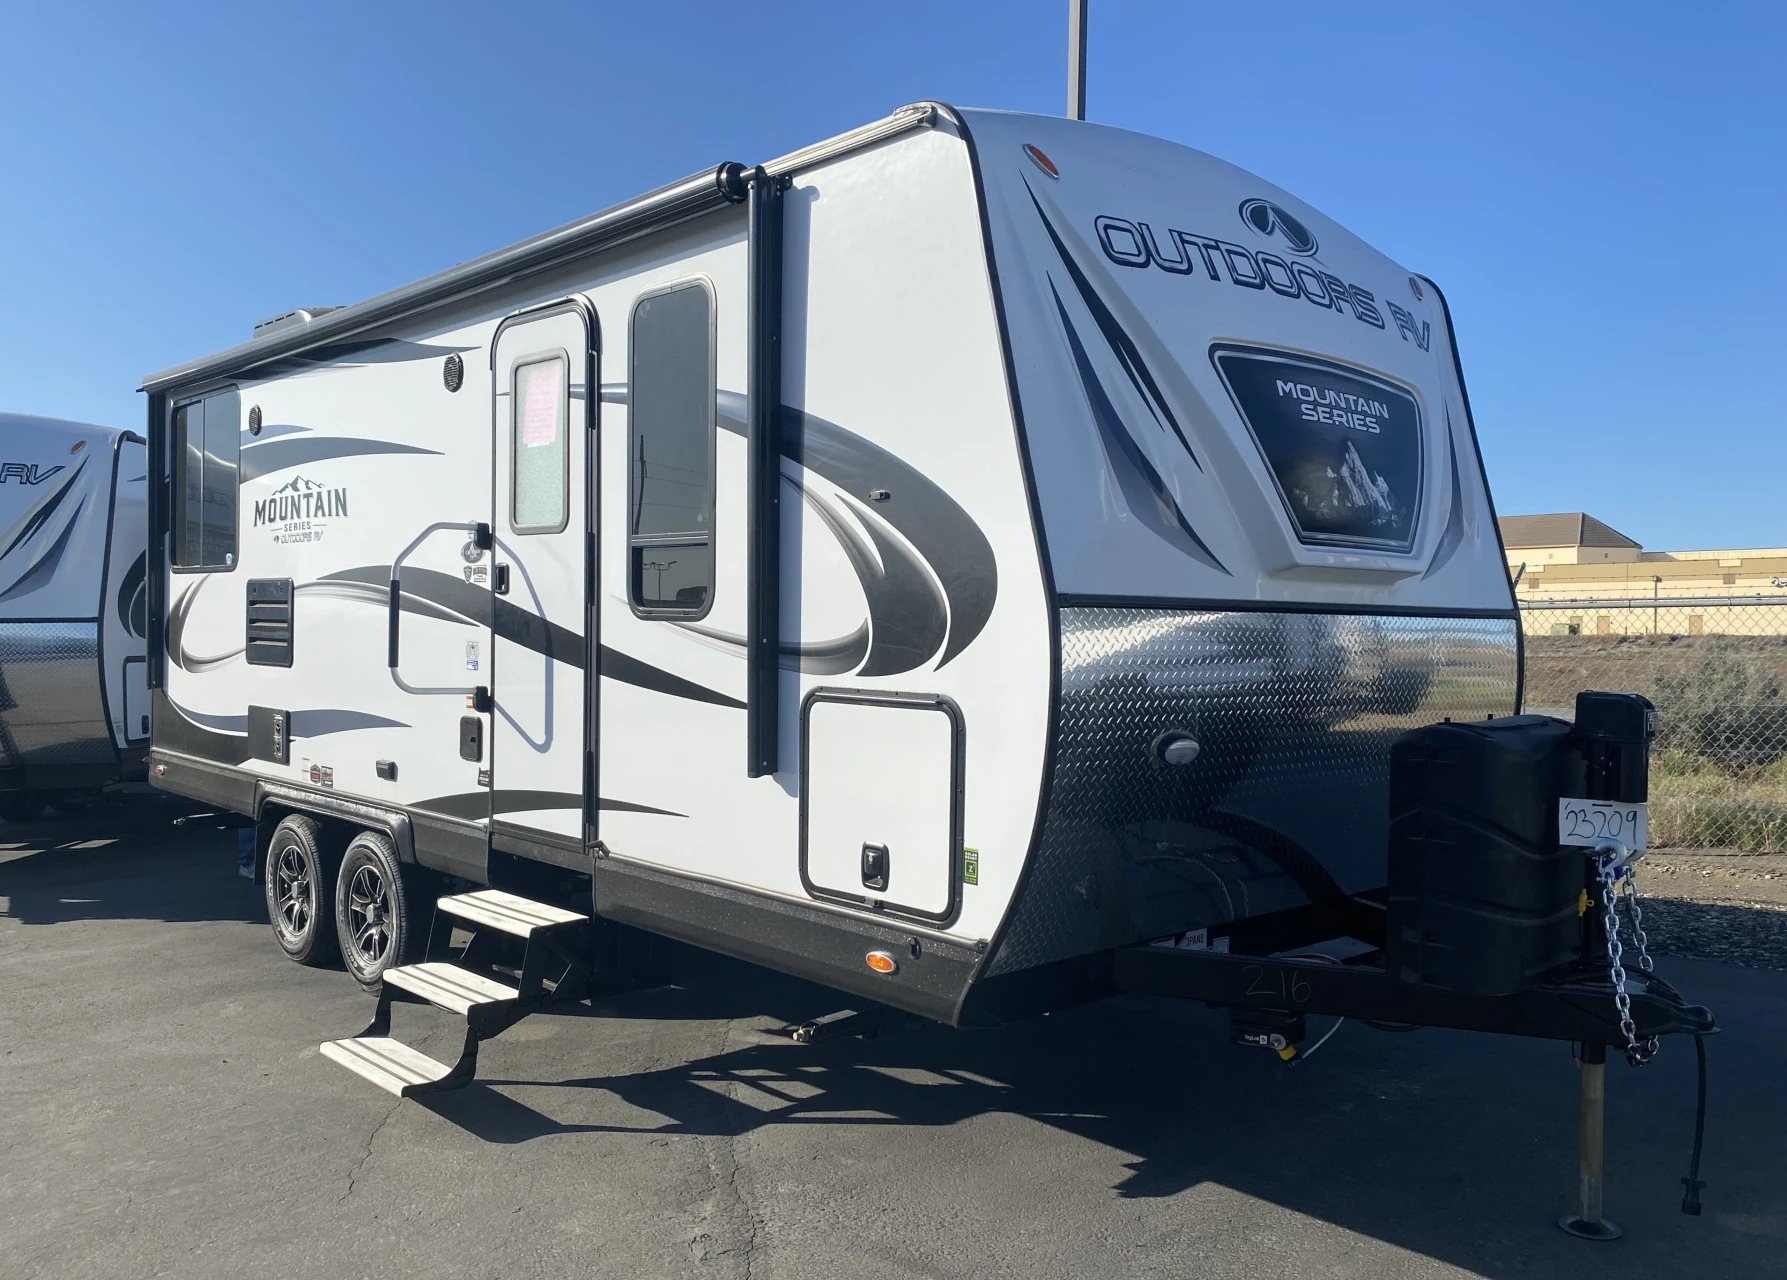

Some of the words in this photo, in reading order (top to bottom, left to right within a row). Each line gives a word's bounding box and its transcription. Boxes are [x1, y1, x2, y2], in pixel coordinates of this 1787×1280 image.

[1094, 215, 1385, 330] OUTDOORS
[1385, 299, 1431, 353] RV
[1275, 379, 1390, 419] MOUNTAIN
[1300, 403, 1381, 434] SERIES
[0, 462, 67, 486] RV
[253, 487, 349, 528] MOUNTAIN
[280, 532, 313, 545] OUTDOORS
[313, 530, 324, 542] RV
[283, 521, 312, 532] SERIES
[1243, 964, 1311, 1003] 216
